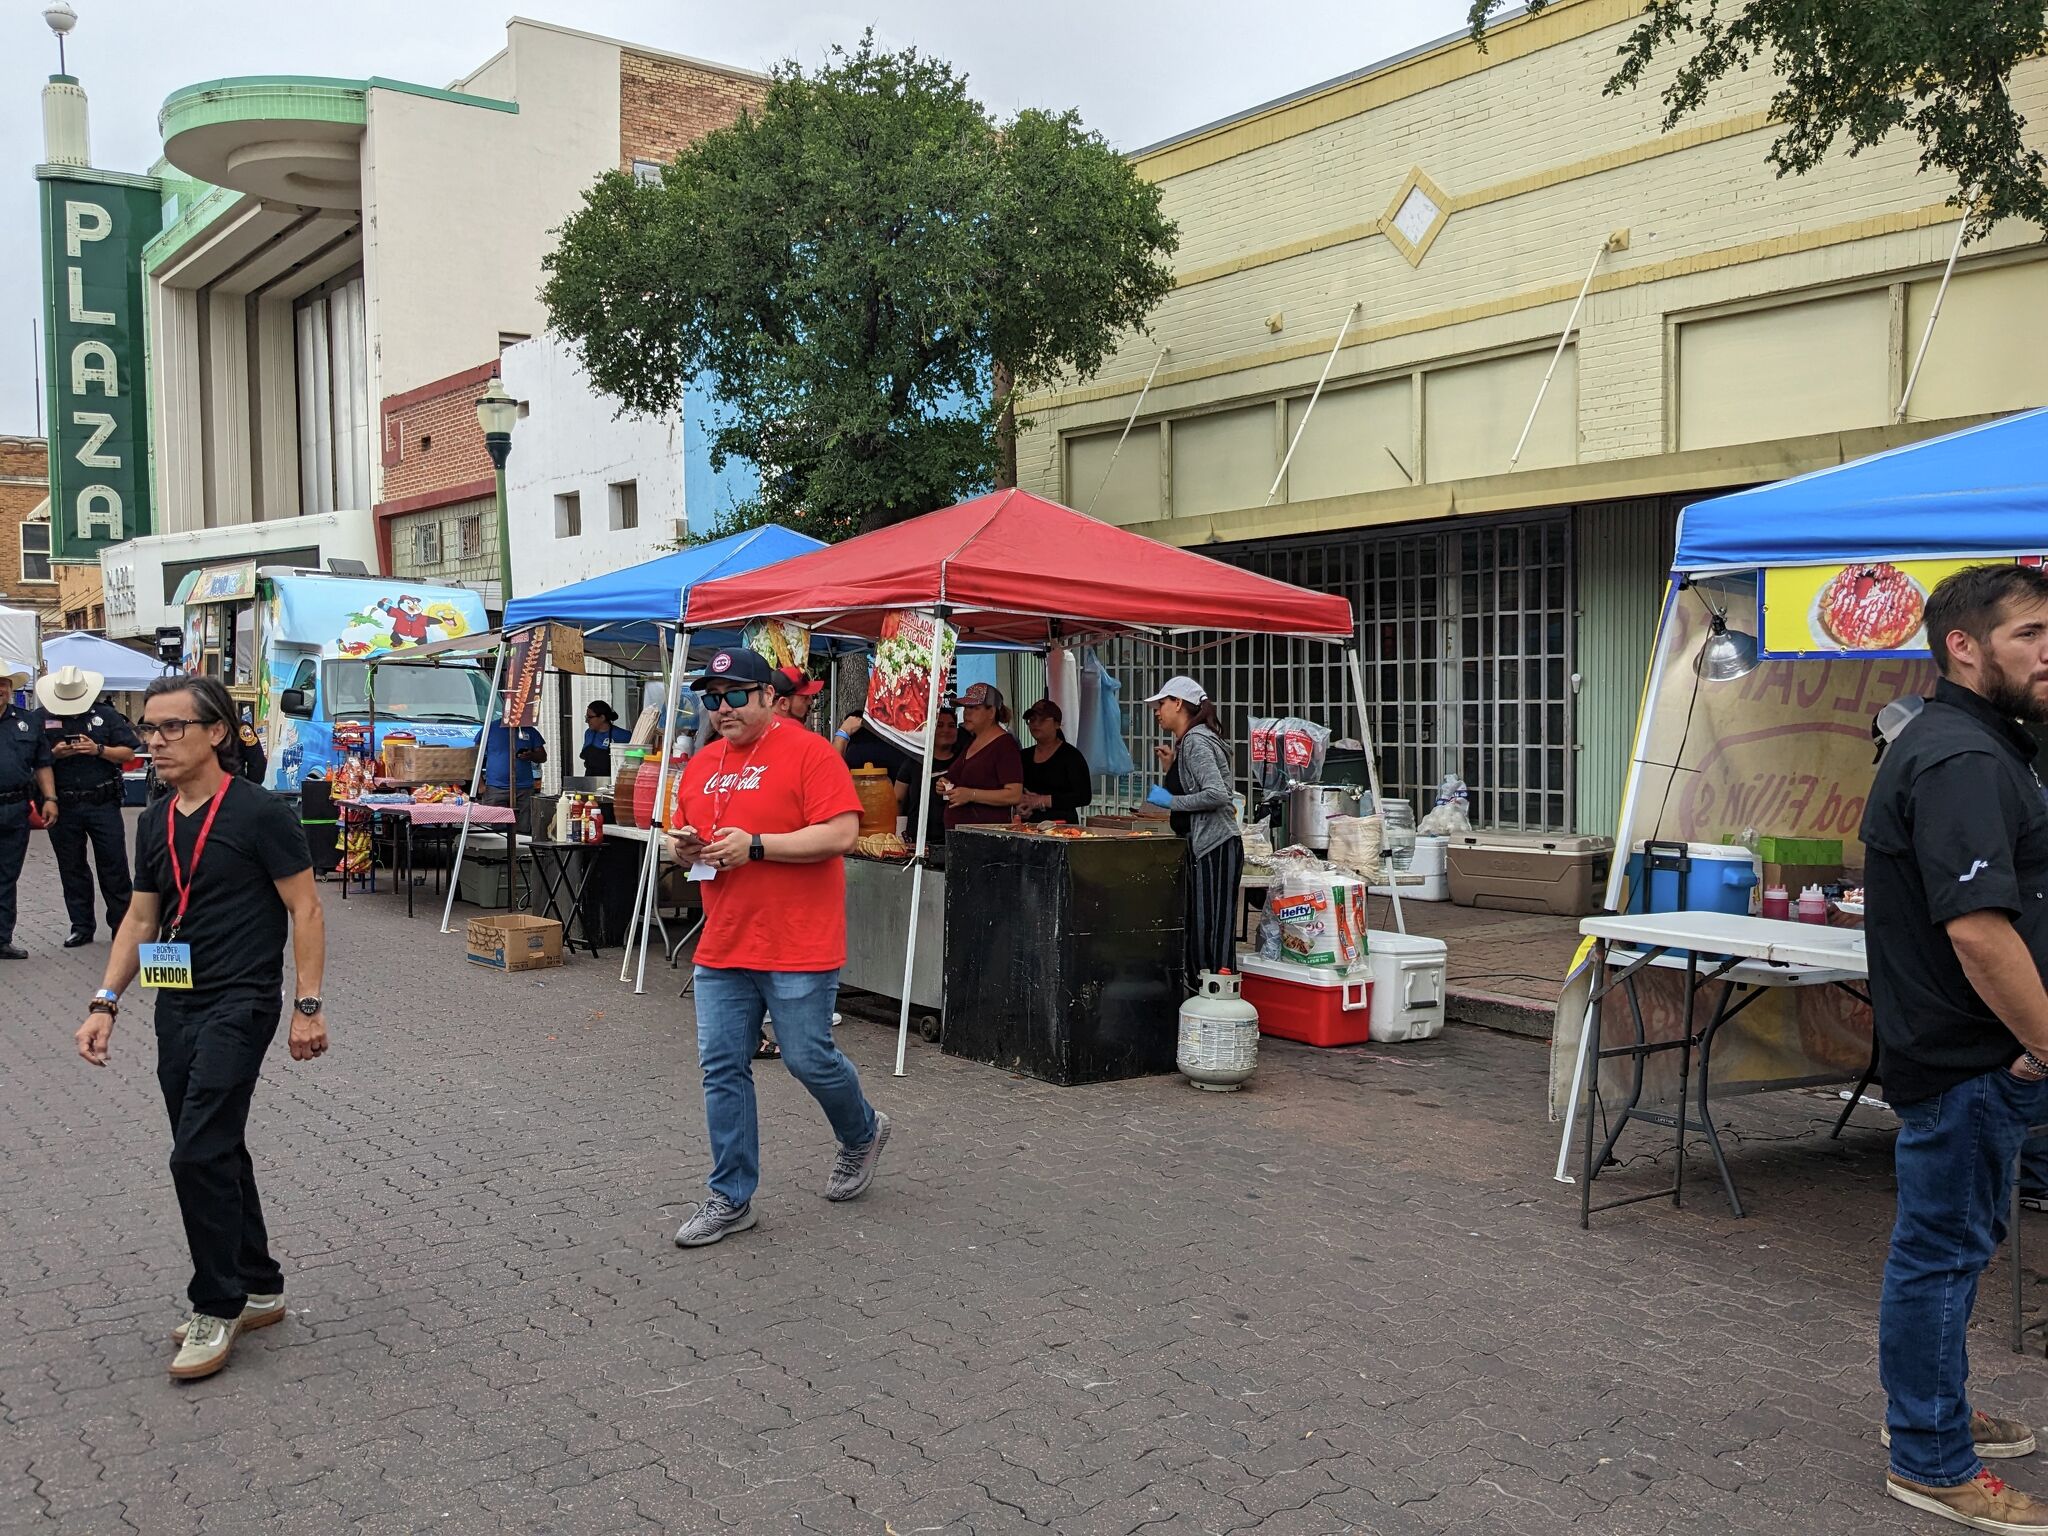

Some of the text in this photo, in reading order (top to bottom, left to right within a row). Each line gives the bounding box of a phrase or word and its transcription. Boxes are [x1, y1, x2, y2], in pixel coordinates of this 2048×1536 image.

[64, 200, 124, 541] PLAZA
[703, 765, 769, 795] CocaCola
[1281, 905, 1311, 918] Hefty
[152, 954, 181, 962] BEAUTIFUL
[144, 966, 188, 984] VENDOR
